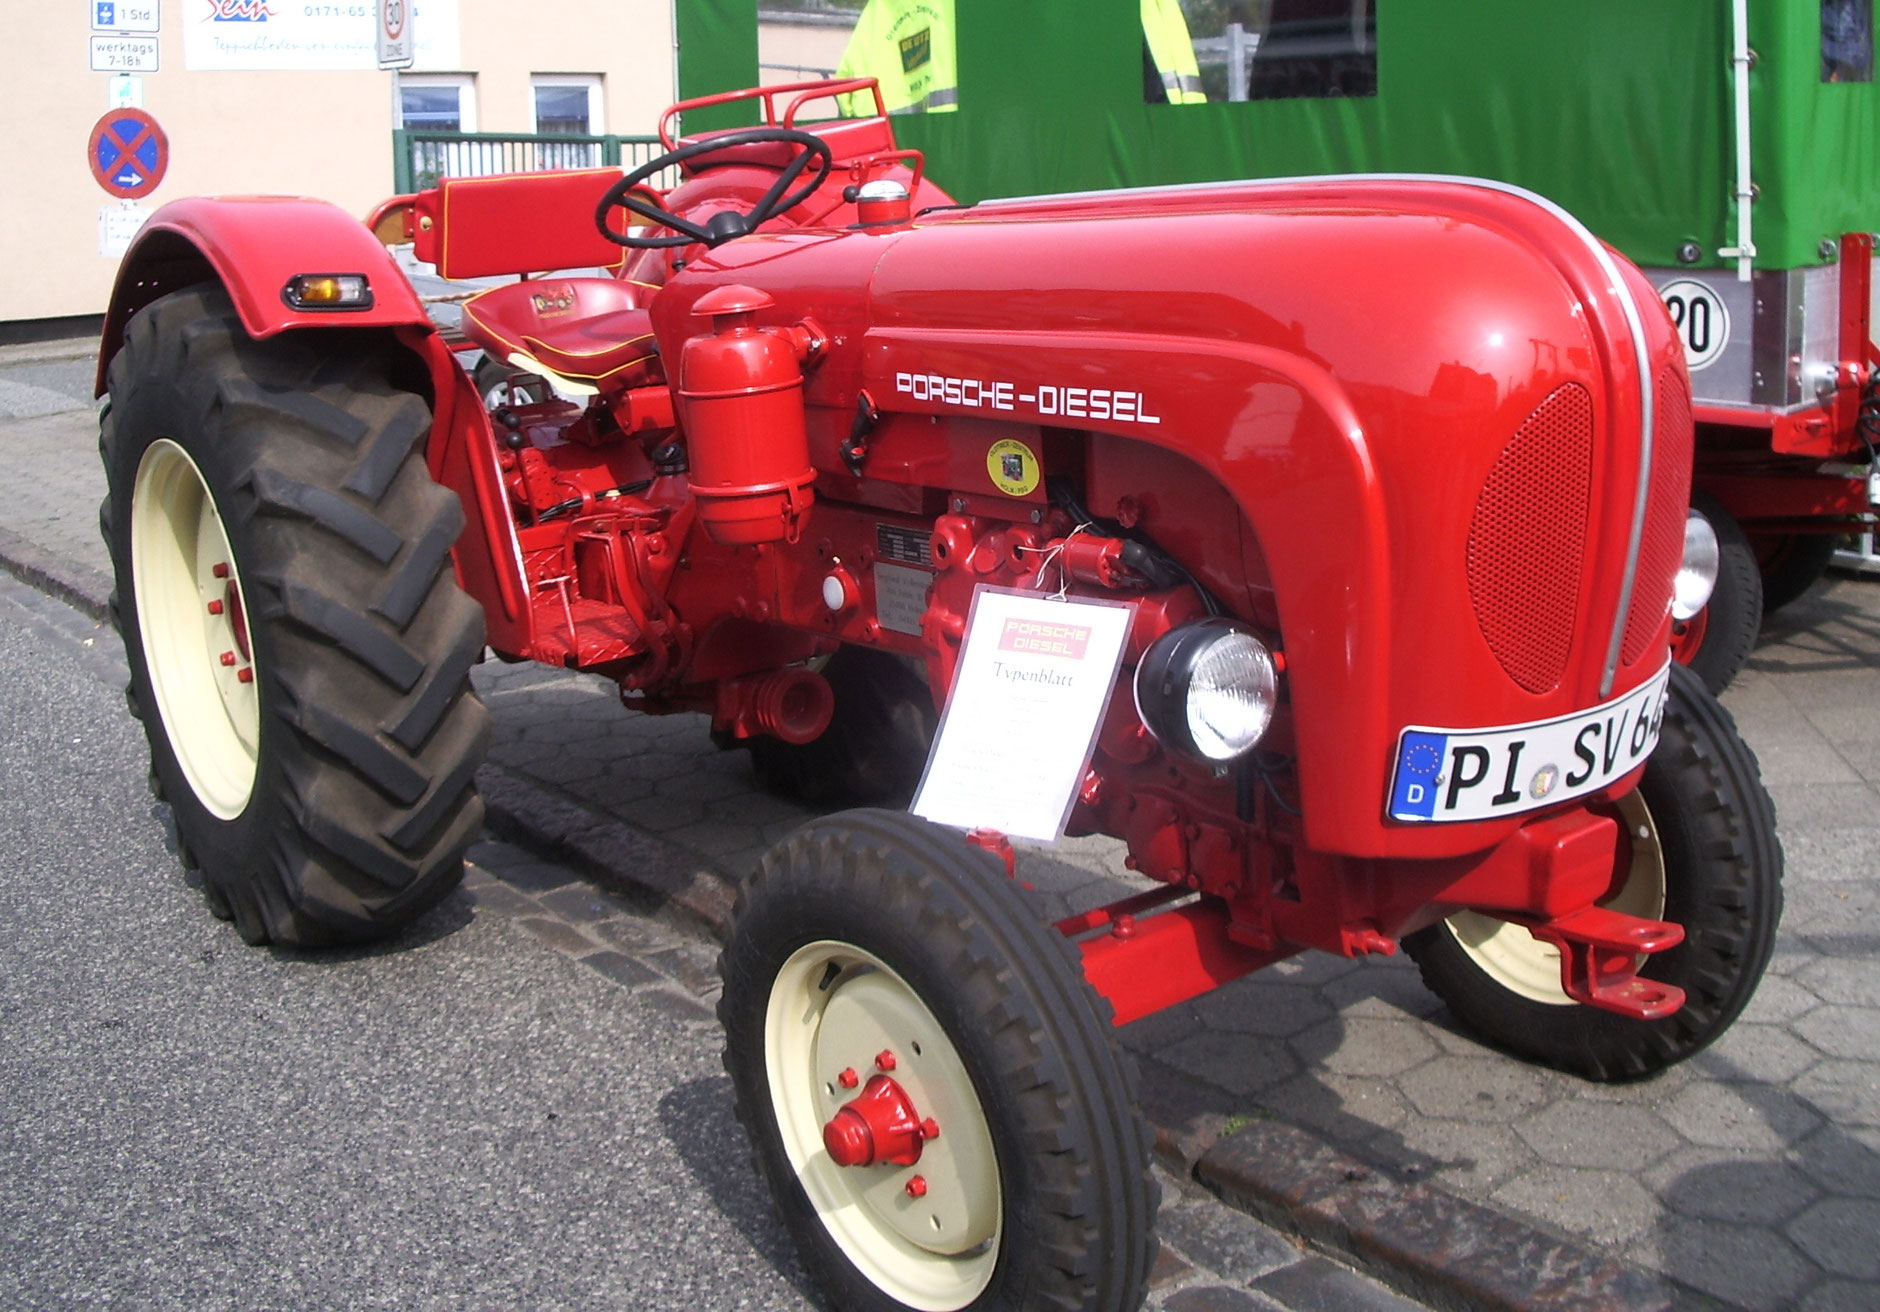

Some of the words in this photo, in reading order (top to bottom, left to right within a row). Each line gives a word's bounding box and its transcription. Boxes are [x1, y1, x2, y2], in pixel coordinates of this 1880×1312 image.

[387, 1, 400, 25] 30
[96, 43, 153, 55] werktags
[1006, 621, 1088, 640] PORSCHE
[1013, 637, 1073, 655] DIESEL
[994, 661, 1074, 687] Typenblatt
[1407, 784, 1425, 803] D
[1445, 741, 1526, 810] PI
[1566, 709, 1630, 787] SV
